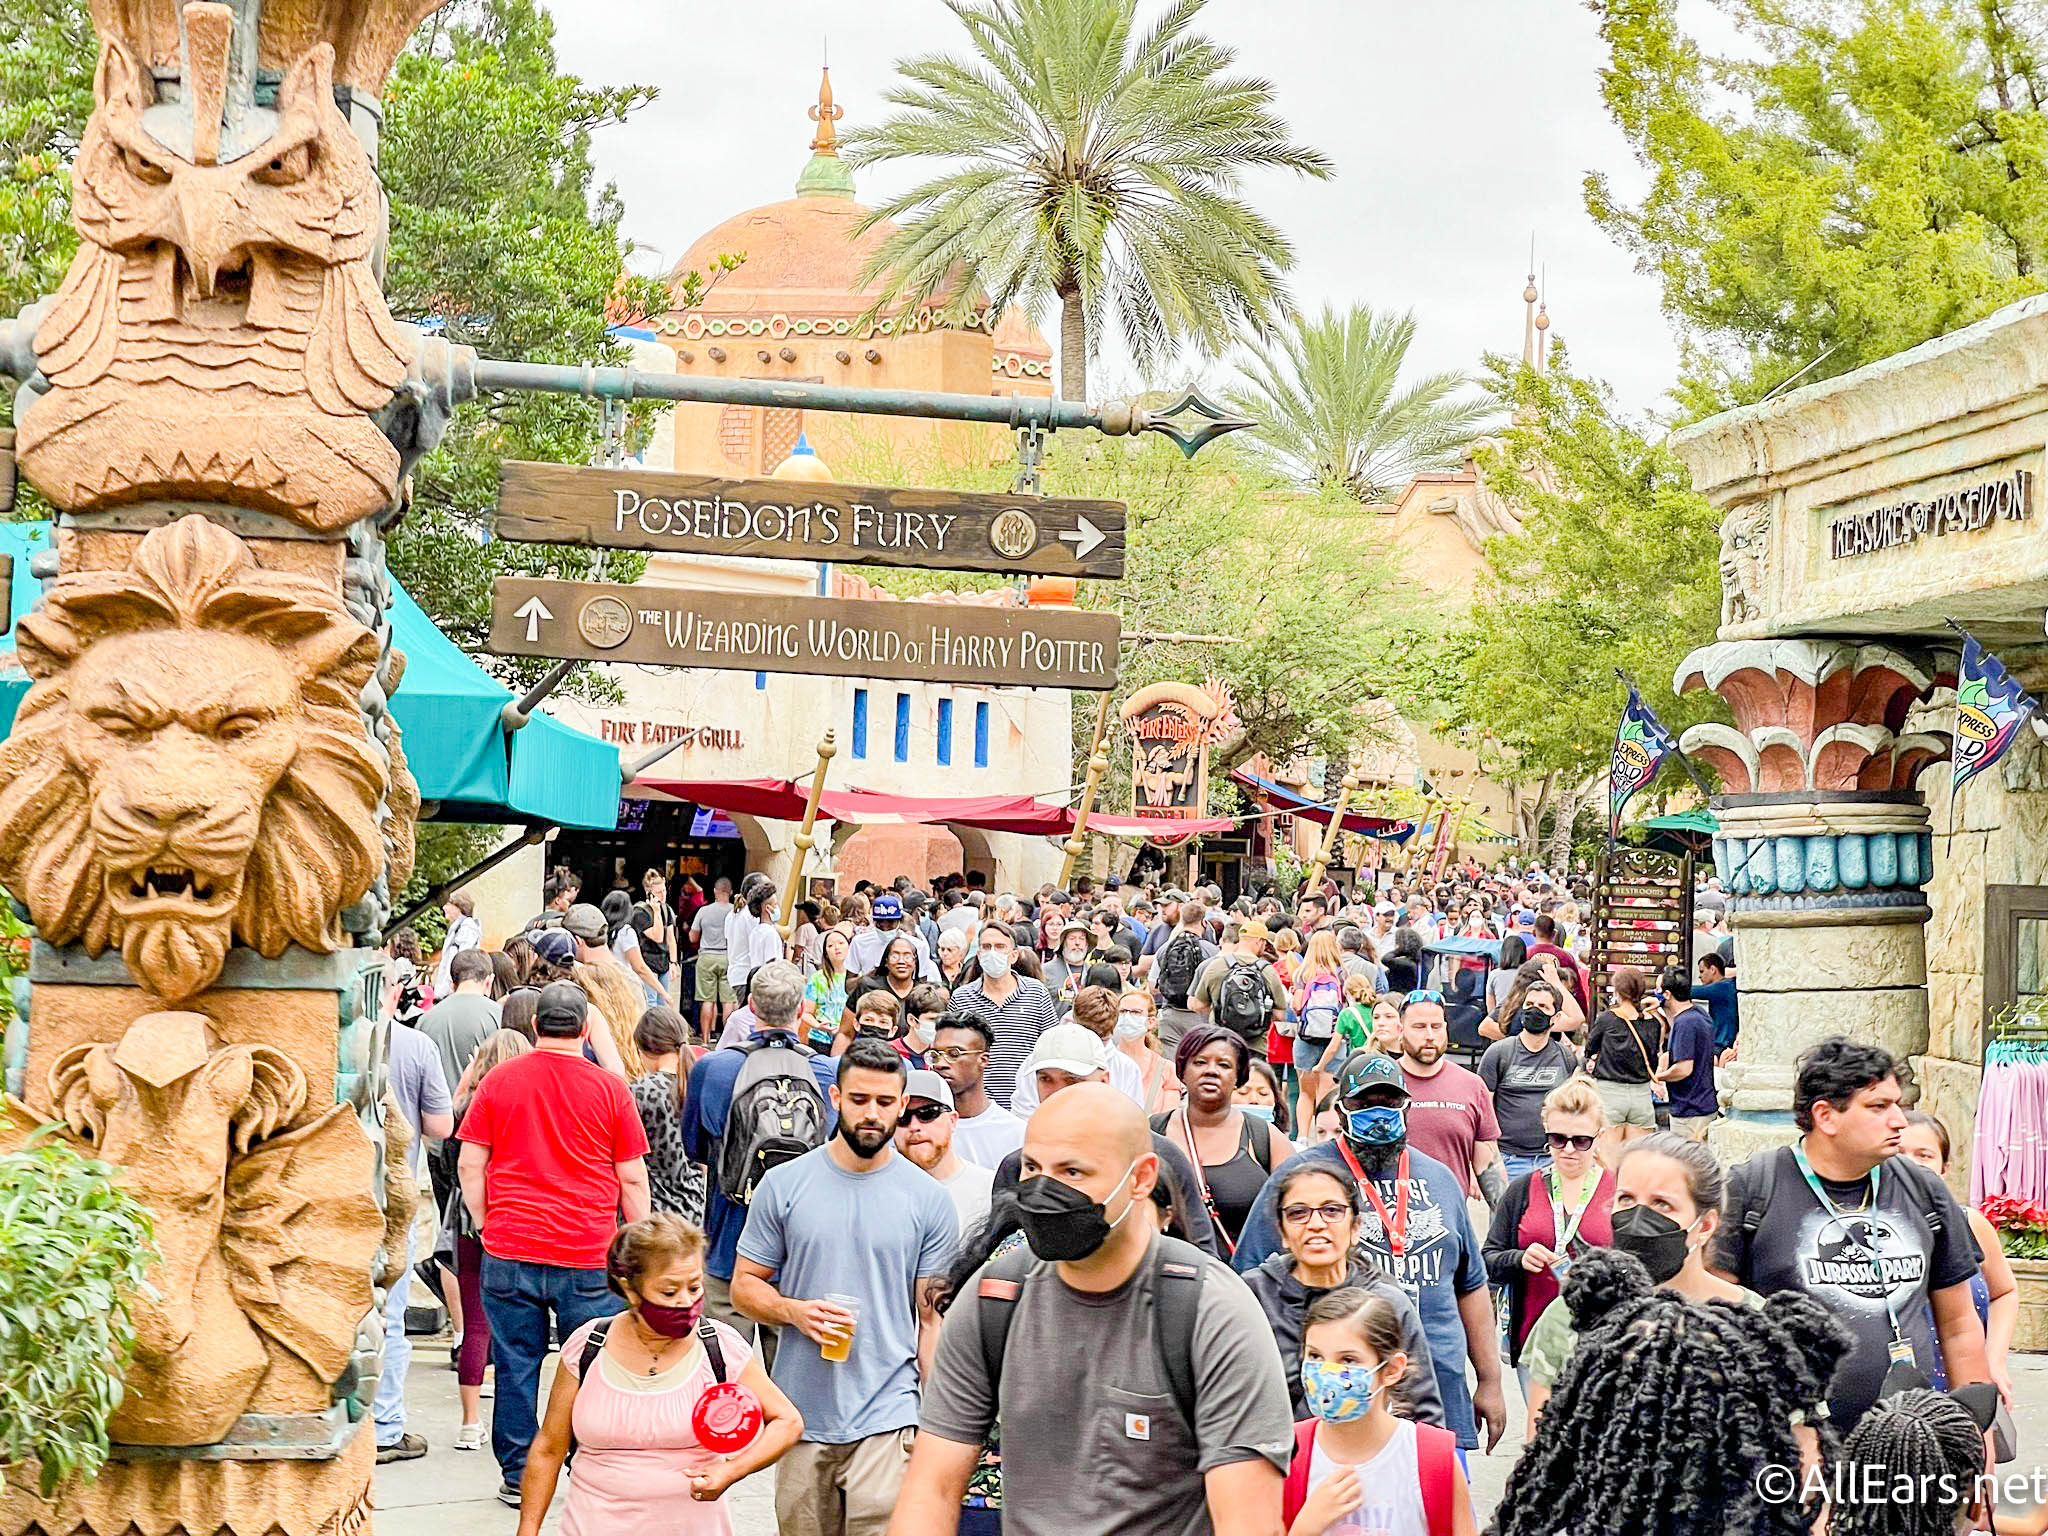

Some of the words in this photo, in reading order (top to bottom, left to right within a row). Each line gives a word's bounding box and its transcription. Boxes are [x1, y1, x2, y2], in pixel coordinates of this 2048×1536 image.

[1934, 470, 2032, 537] POSEIDON
[613, 489, 840, 545] POSEIDON'S
[851, 503, 957, 551] FURY
[637, 609, 663, 626] THE
[663, 609, 800, 659] WIZARDING
[807, 618, 901, 663] WORLD
[903, 640, 927, 664] OF
[930, 626, 1014, 669] HARRY
[1020, 630, 1106, 675] POTTER
[600, 719, 638, 745] FIRE
[698, 725, 745, 752] GRILL
[1138, 718, 1165, 741] FIRE
[1958, 708, 1994, 738] XPRESS
[1612, 752, 1643, 781] SOLD
[1620, 742, 1649, 766] EXPRESS
[1615, 886, 1665, 897] RESTROOMS
[1622, 958, 1653, 966] LAGOON
[1808, 1260, 1880, 1284] JURASSIC
[1880, 1255, 1922, 1284] PARK
